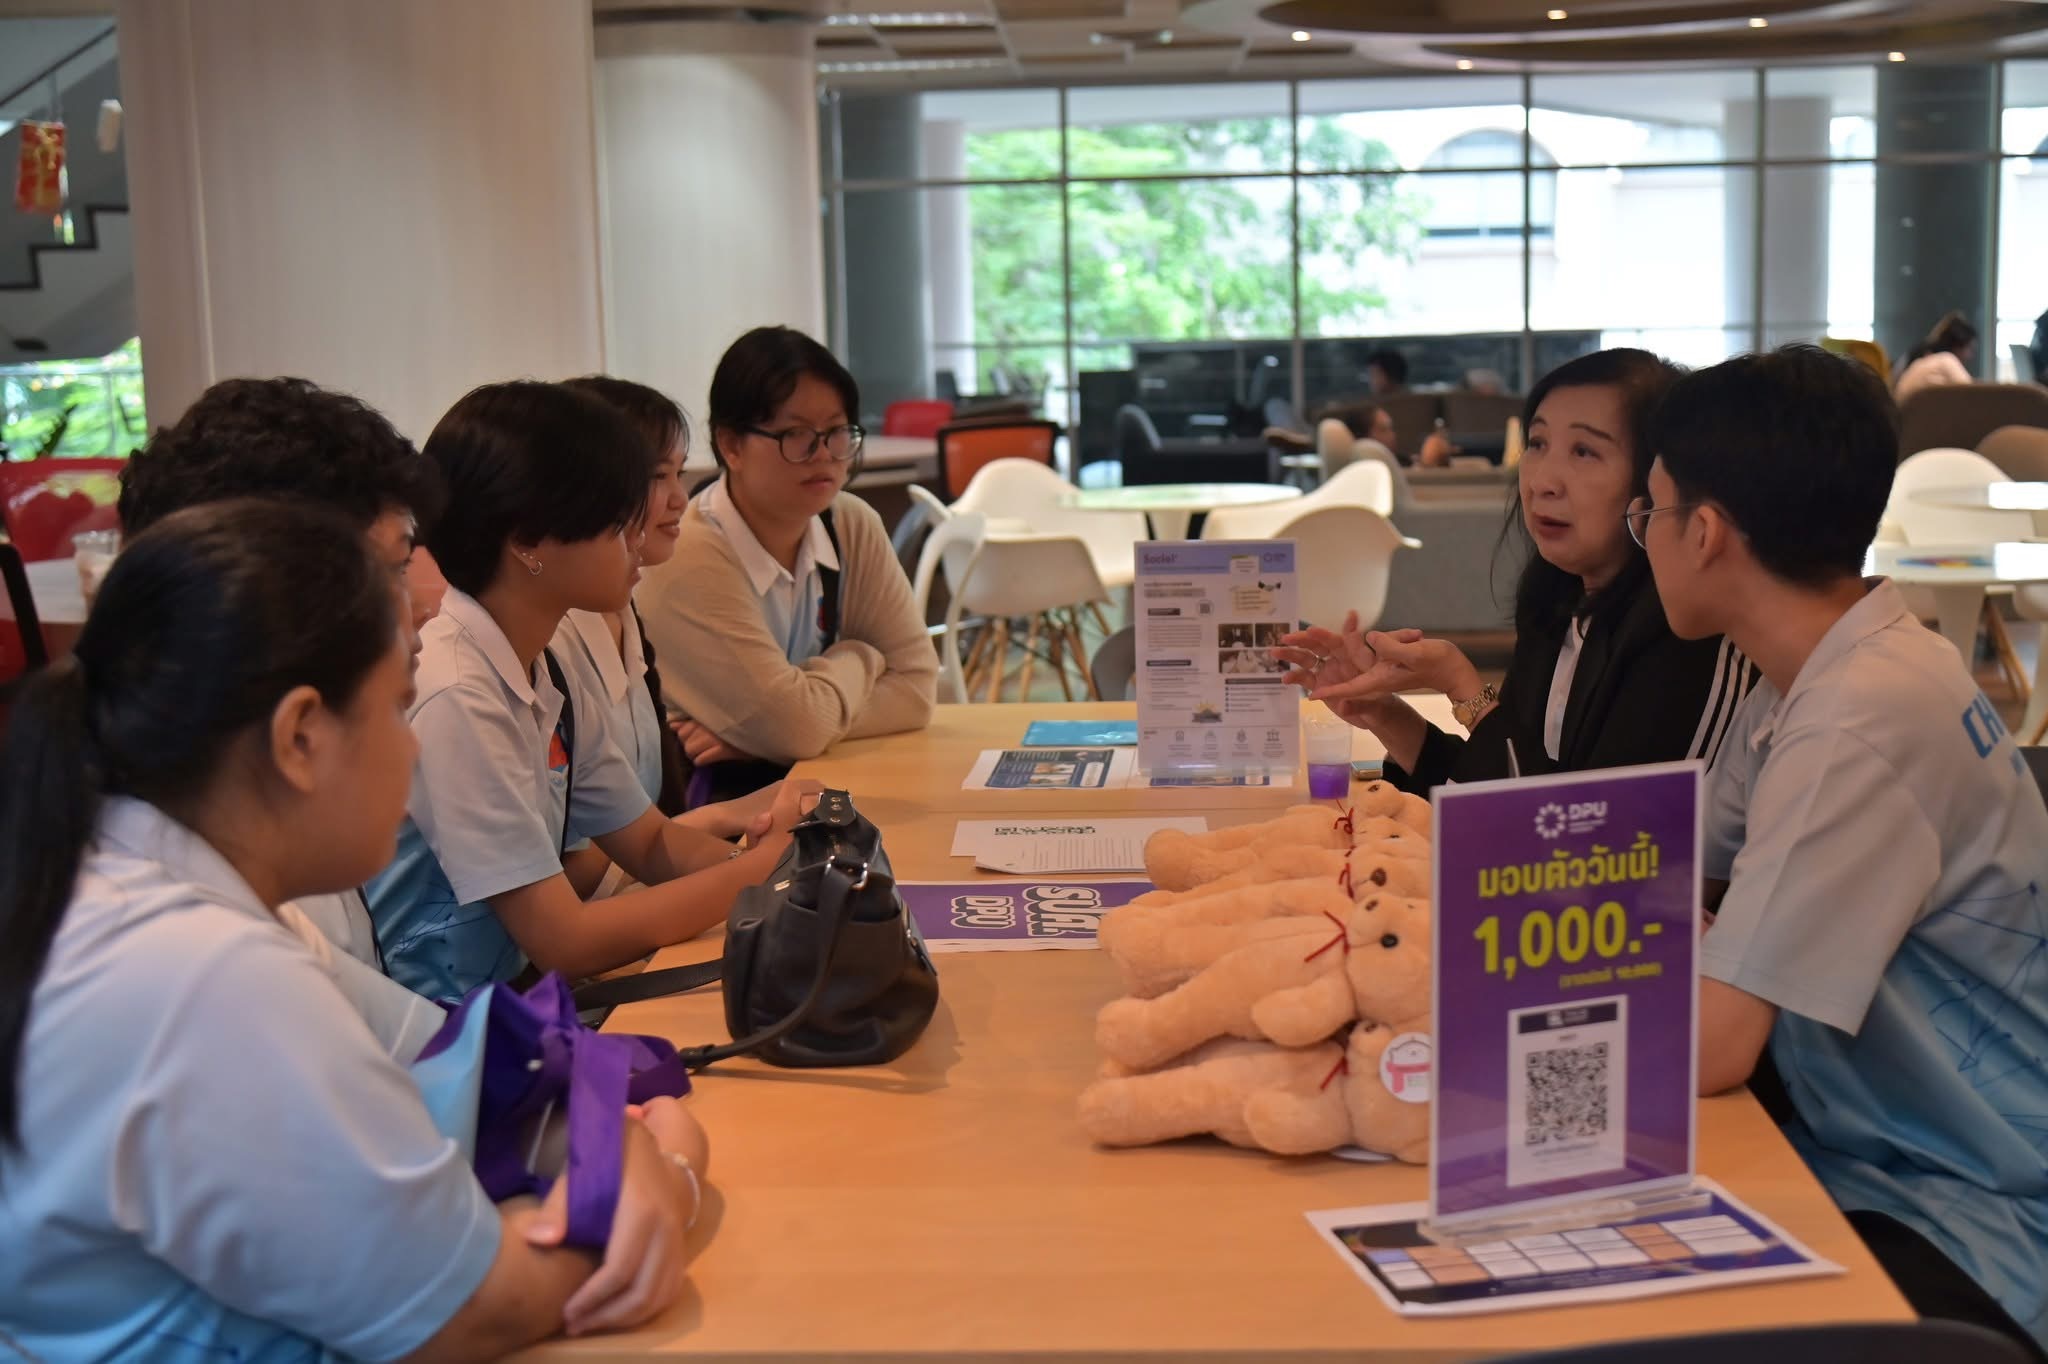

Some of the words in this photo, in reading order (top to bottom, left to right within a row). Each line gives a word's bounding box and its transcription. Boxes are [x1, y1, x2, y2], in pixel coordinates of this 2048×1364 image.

[1568, 801, 1608, 820] DPU
[1478, 831, 1659, 898] มอบตัววันนี้!
[951, 894, 1017, 929] DPU
[1473, 901, 1662, 981] 1,000.-
